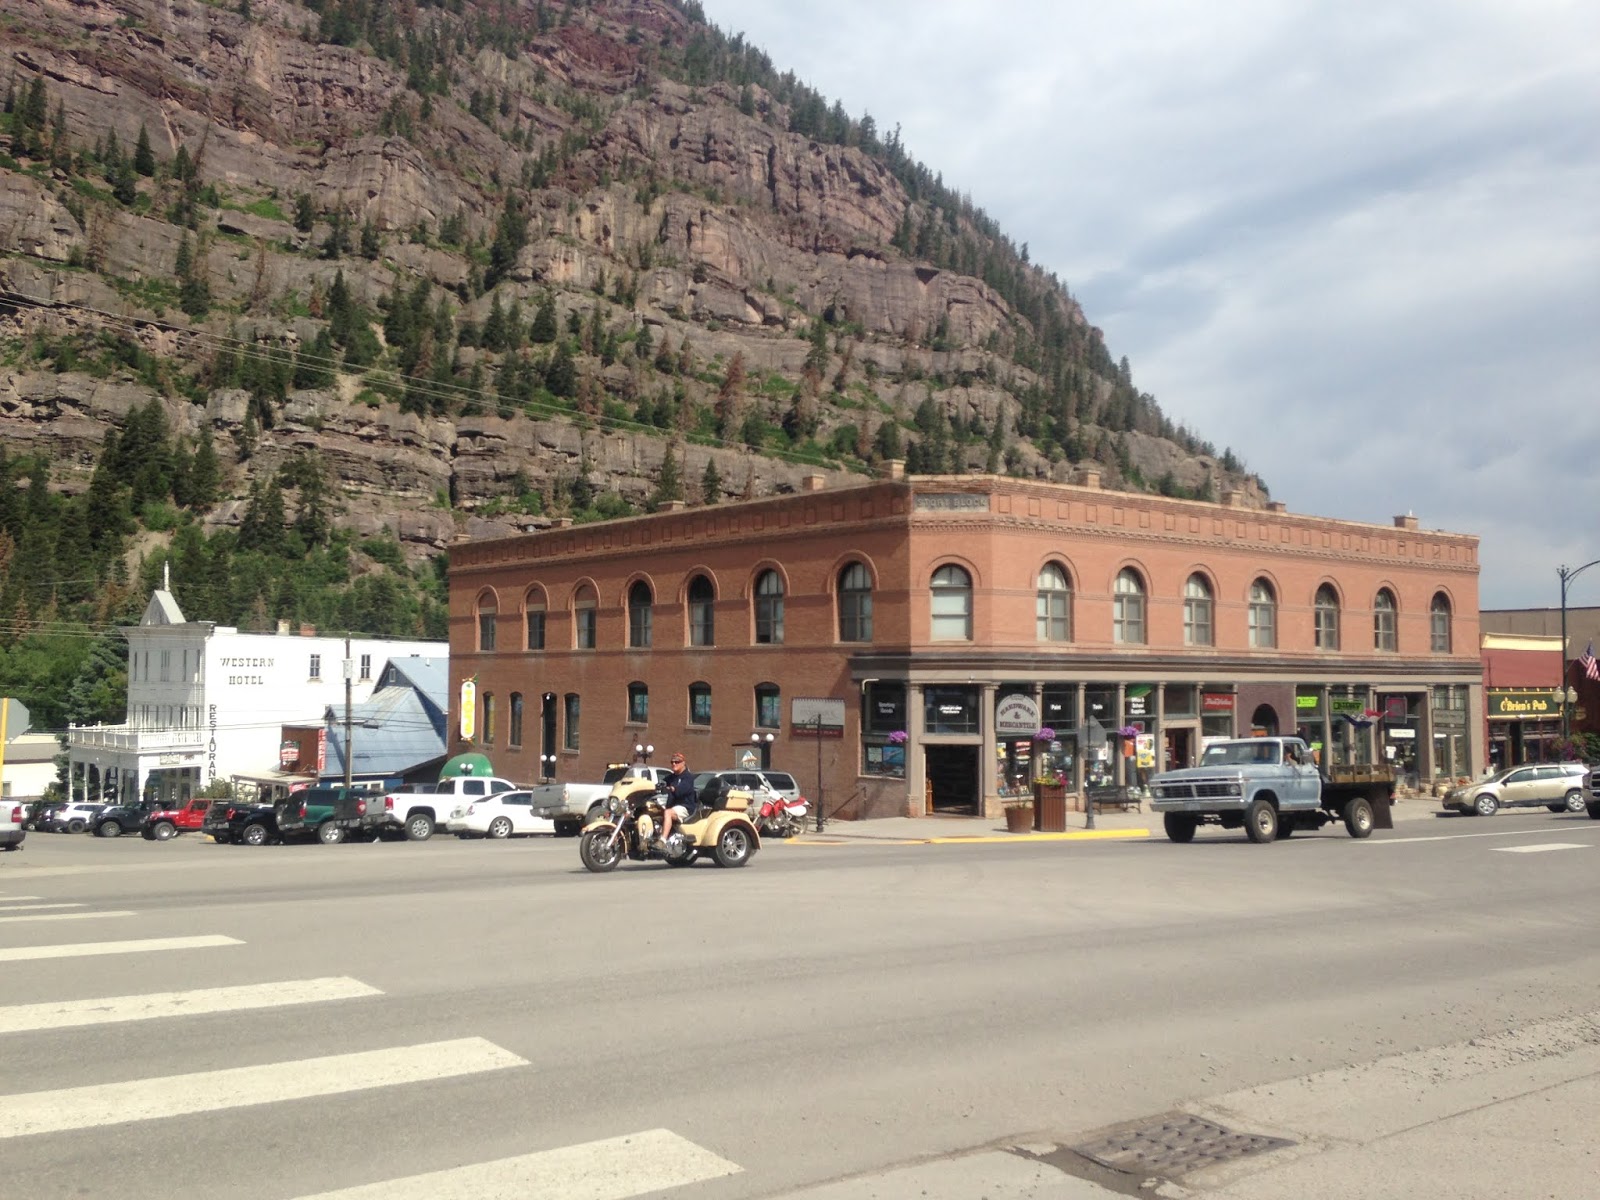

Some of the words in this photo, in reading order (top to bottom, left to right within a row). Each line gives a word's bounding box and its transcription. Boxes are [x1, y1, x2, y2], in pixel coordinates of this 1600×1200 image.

[954, 498, 986, 507] BLOCK
[219, 657, 275, 667] WESTERN
[228, 675, 264, 685] HOTEL
[1000, 703, 1036, 717] HARDWARE
[1532, 699, 1548, 711] Pub
[999, 721, 1037, 729] MERCANTILE
